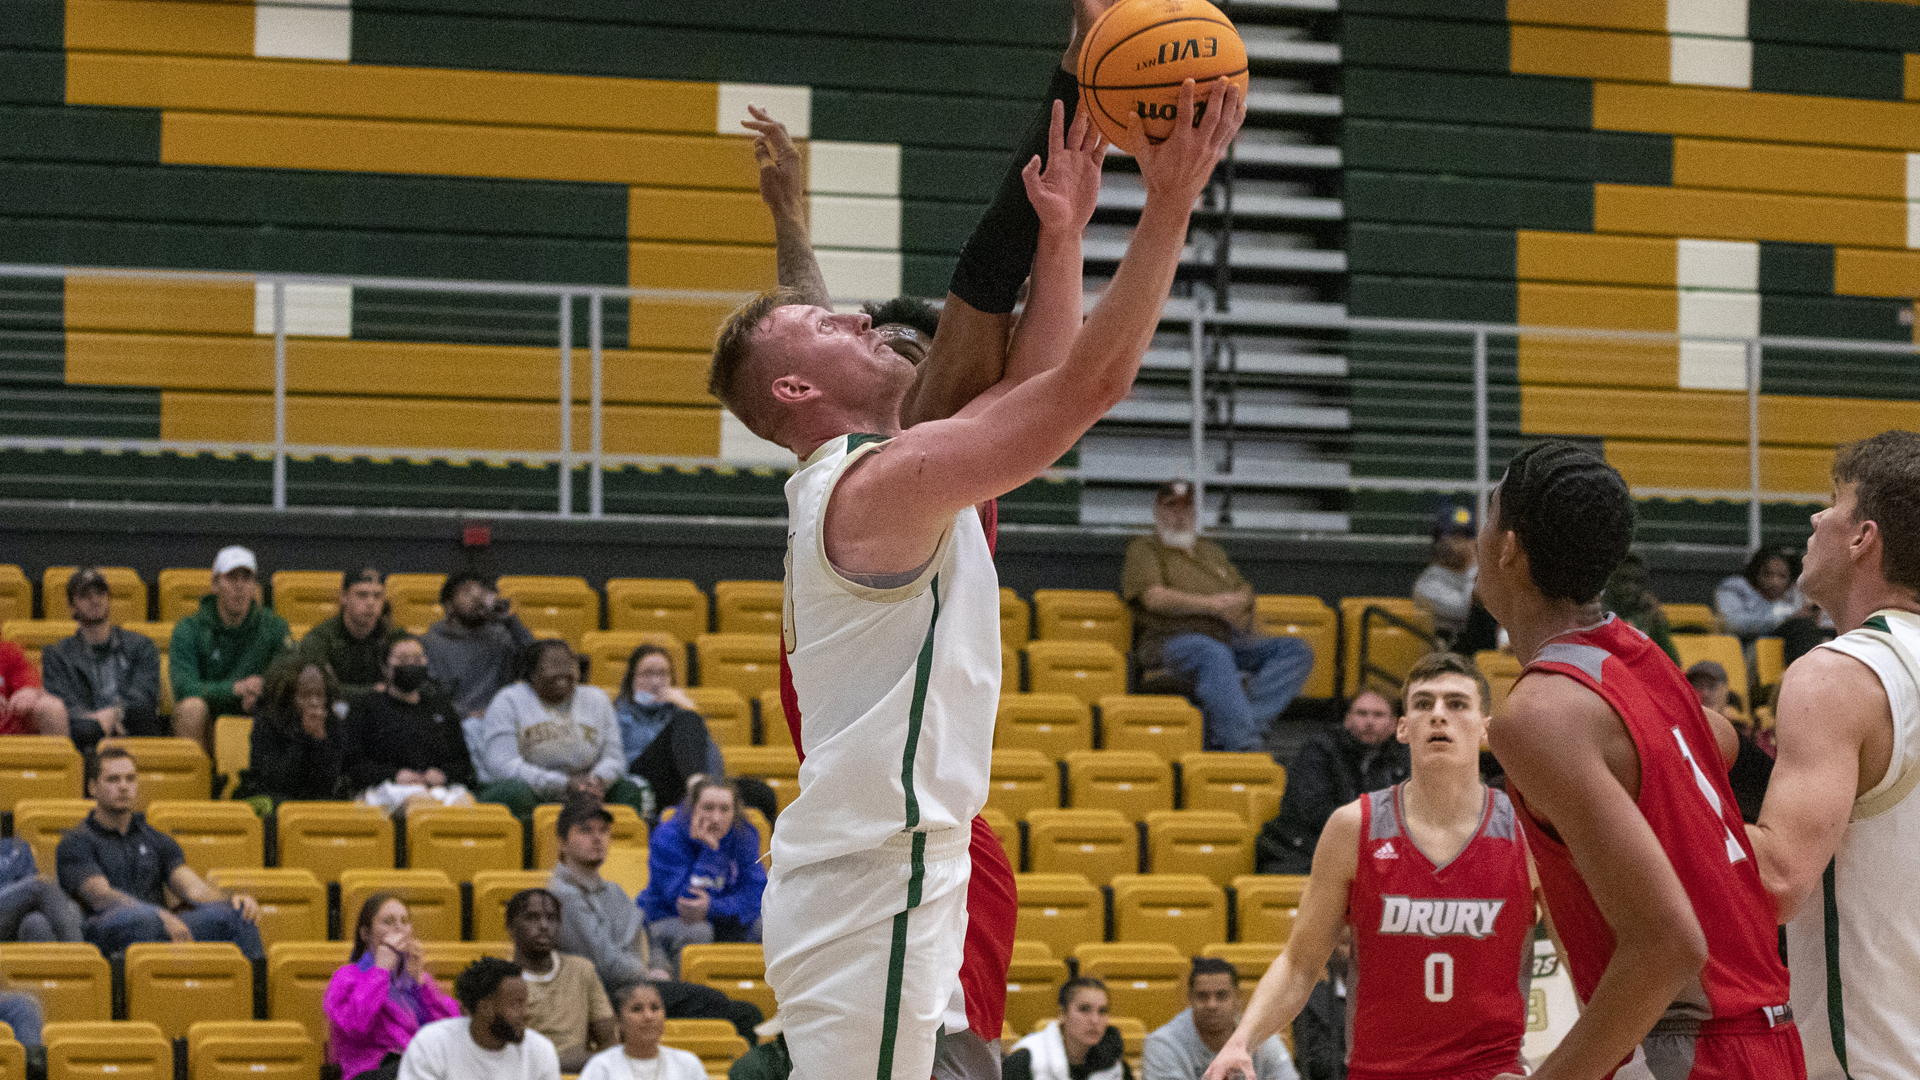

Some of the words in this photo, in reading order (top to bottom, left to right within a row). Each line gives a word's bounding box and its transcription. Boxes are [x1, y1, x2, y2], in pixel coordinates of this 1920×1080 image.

[1158, 37, 1218, 65] EVO
[1671, 725, 1748, 865] 1
[1379, 894, 1507, 939] DRURY
[1424, 952, 1454, 1003] 0
